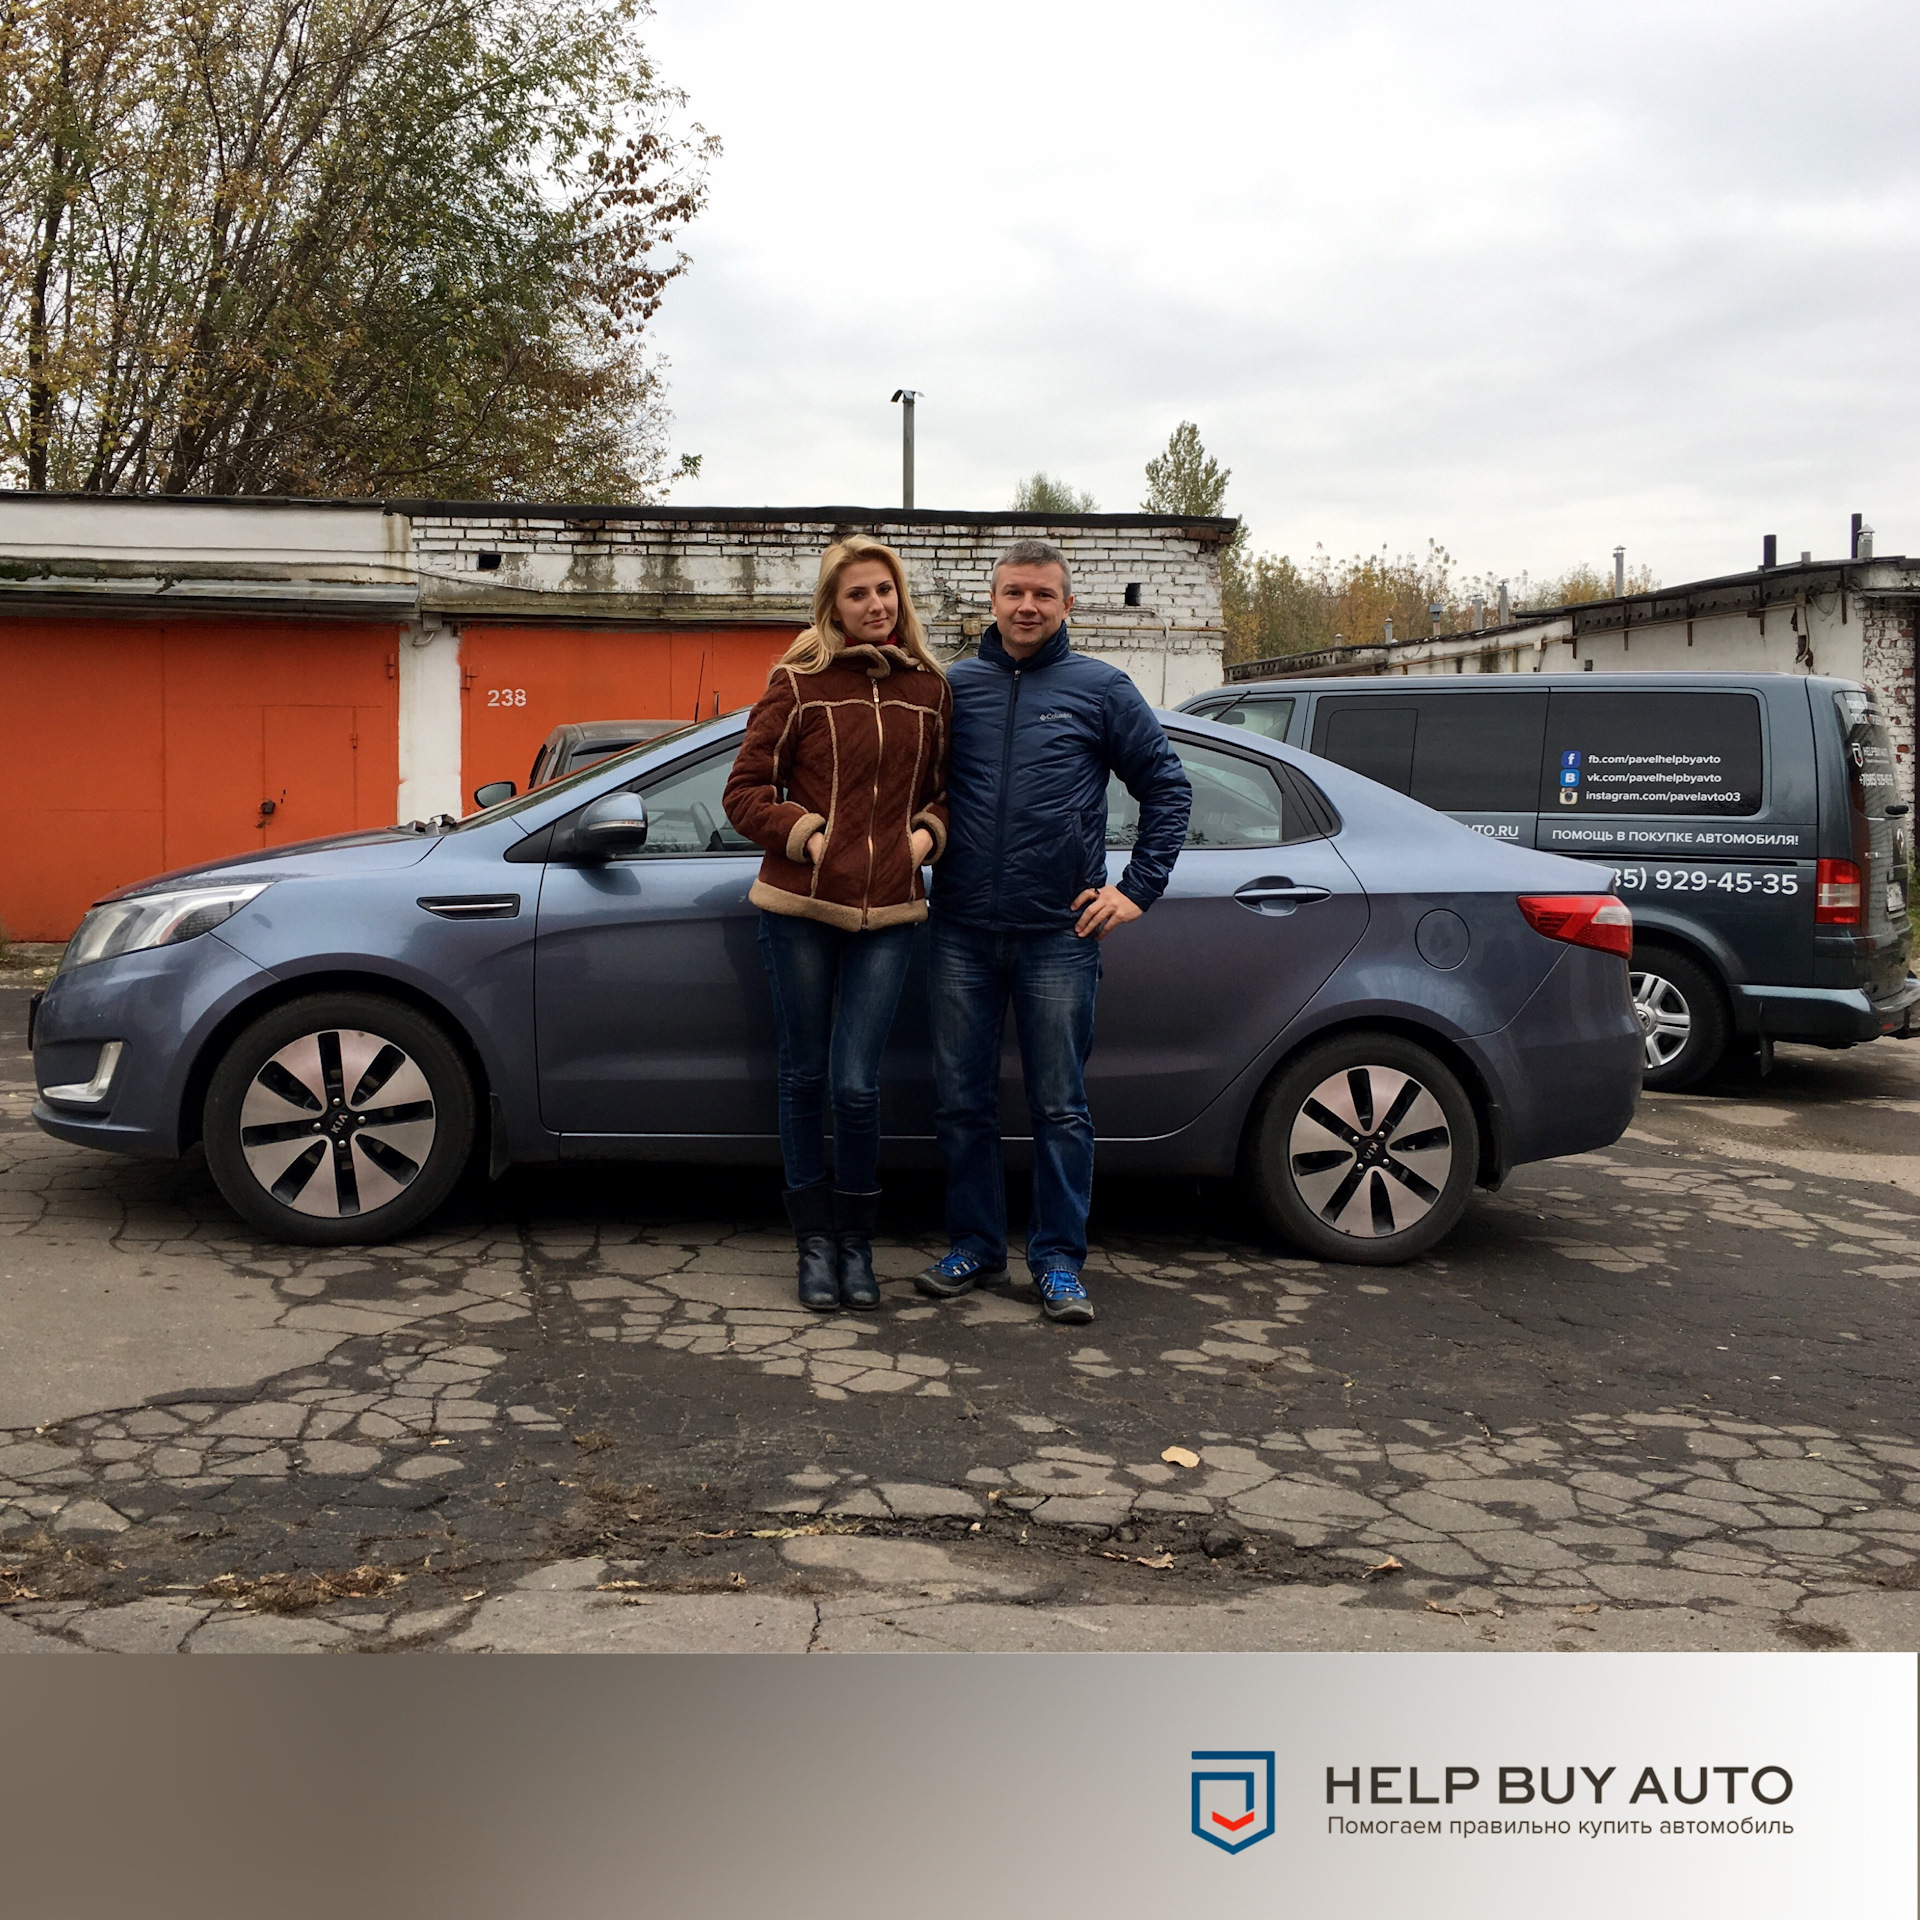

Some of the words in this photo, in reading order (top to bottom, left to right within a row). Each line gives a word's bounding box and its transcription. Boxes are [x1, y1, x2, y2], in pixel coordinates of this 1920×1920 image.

[487, 688, 527, 707] 238
[1588, 754, 1722, 766] fb.com/pavelhelpbyavto
[1586, 772, 1723, 784] vk.com/pavelhelpbyavto
[1585, 790, 1741, 803] instagram.com/pavelavto03
[1552, 829, 1614, 842] ПОМОЩЬ
[1616, 831, 1626, 842] В
[1628, 832, 1693, 843] ПОКУПКЕ
[1695, 833, 1800, 846] АВТОМОБИЛЯ!
[1655, 869, 1799, 895] 929-45-35
[330, 1114, 348, 1134] KIA
[1363, 1141, 1379, 1160] KIA
